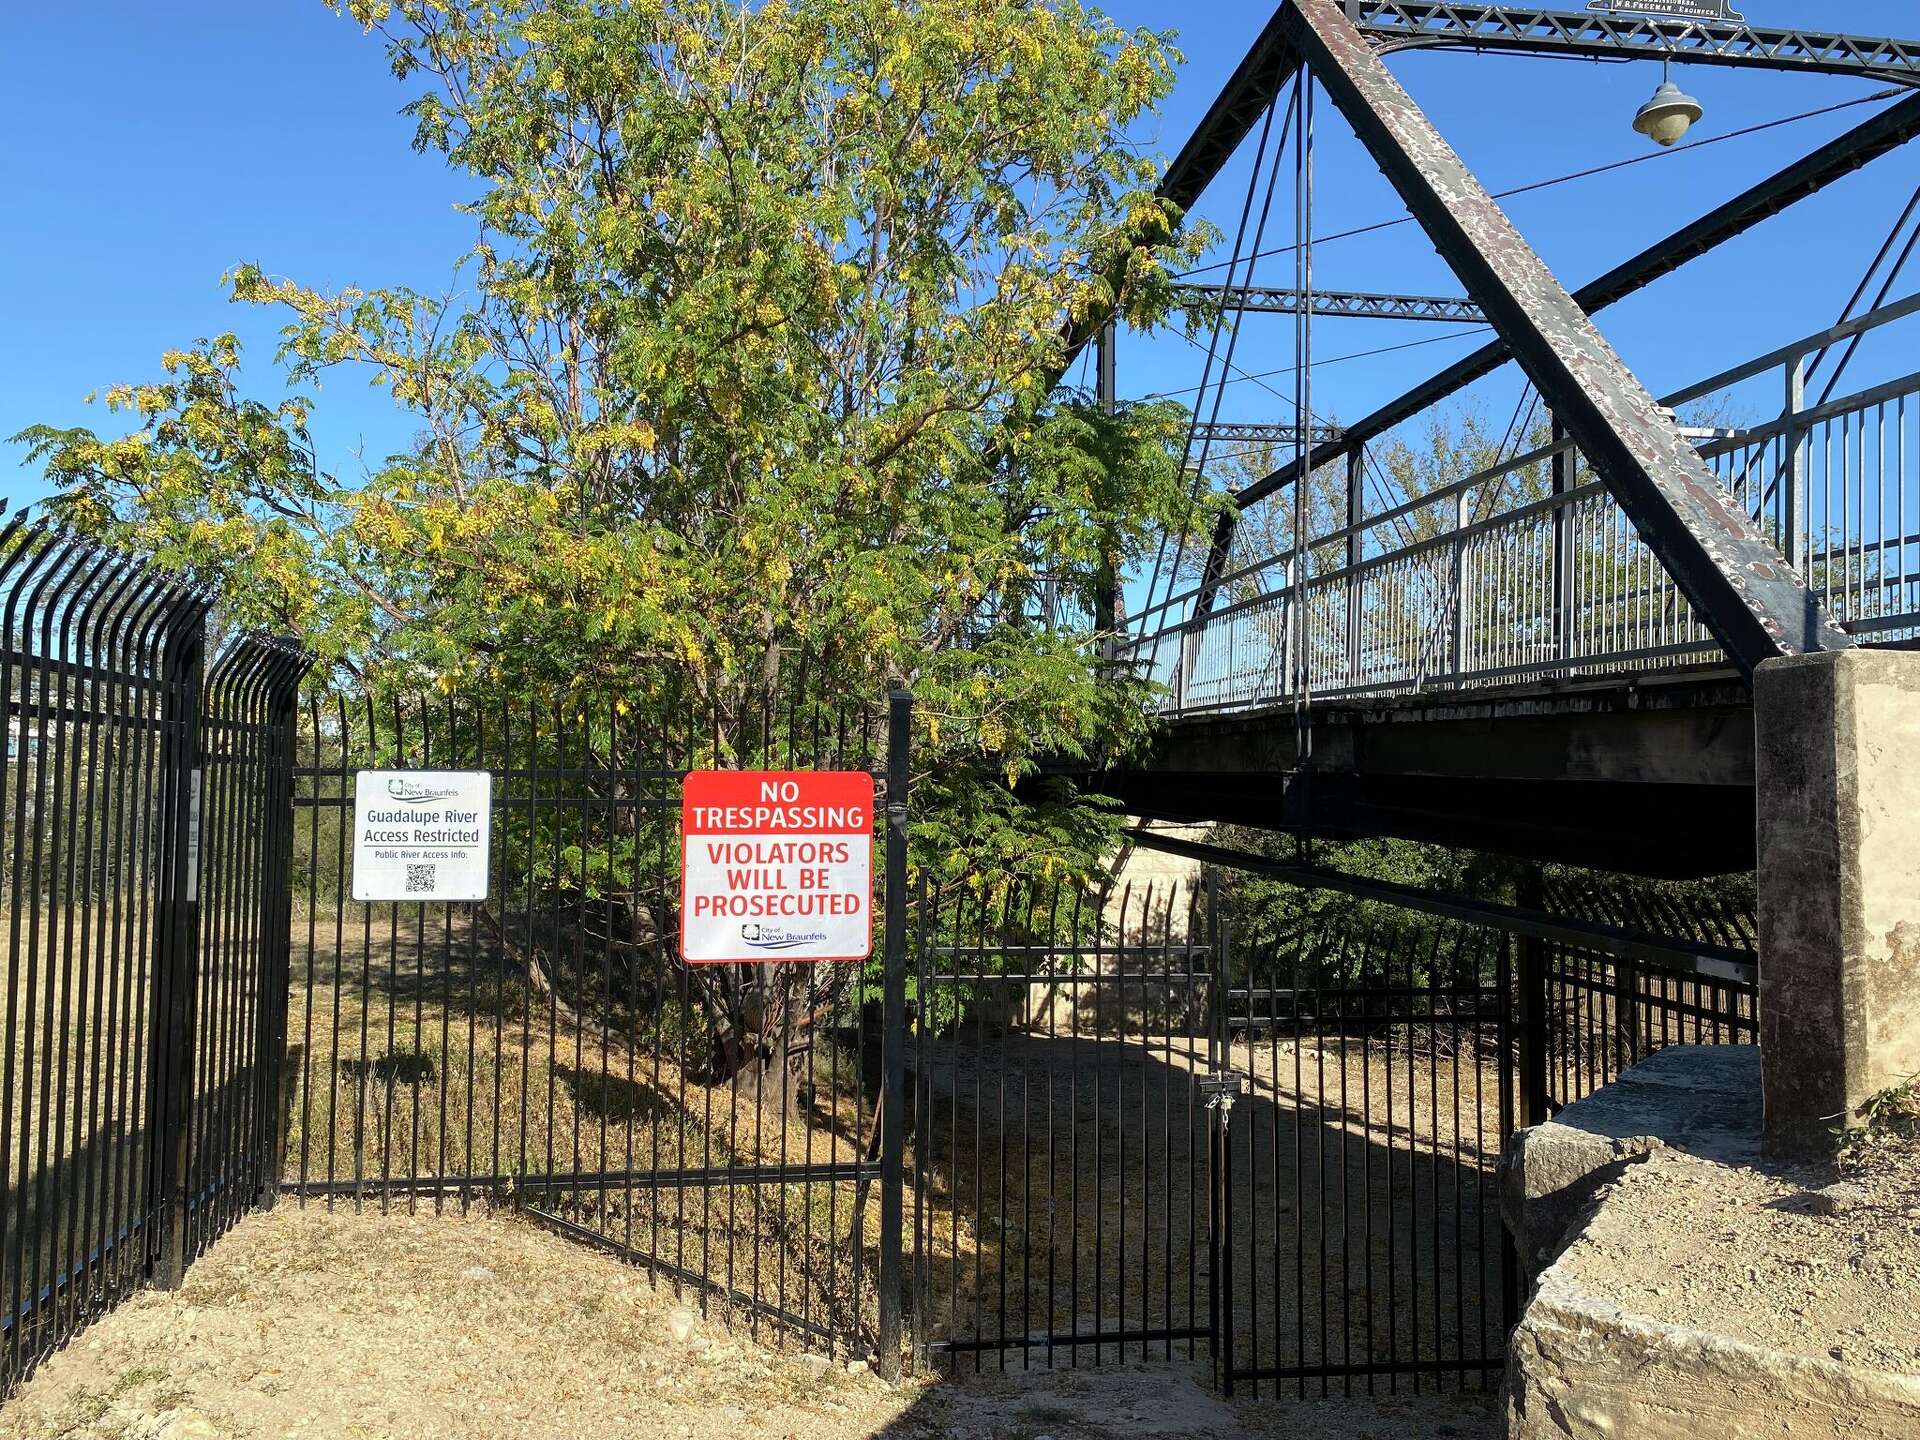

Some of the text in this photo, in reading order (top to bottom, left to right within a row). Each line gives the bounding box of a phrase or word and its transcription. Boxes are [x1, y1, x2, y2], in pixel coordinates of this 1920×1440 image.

[424, 788, 459, 797] Braunfels
[760, 781, 800, 802] NO
[367, 809, 478, 826] Guadalupe River
[692, 807, 864, 829] TRESPASSING
[364, 829, 479, 842] Access Restricted
[375, 850, 468, 859] Public River Access Info:
[707, 842, 849, 864] VIOLATORS
[727, 868, 830, 890] WILL BE
[694, 893, 861, 917] PROSECUTED
[761, 932, 827, 941] New Braunfels
